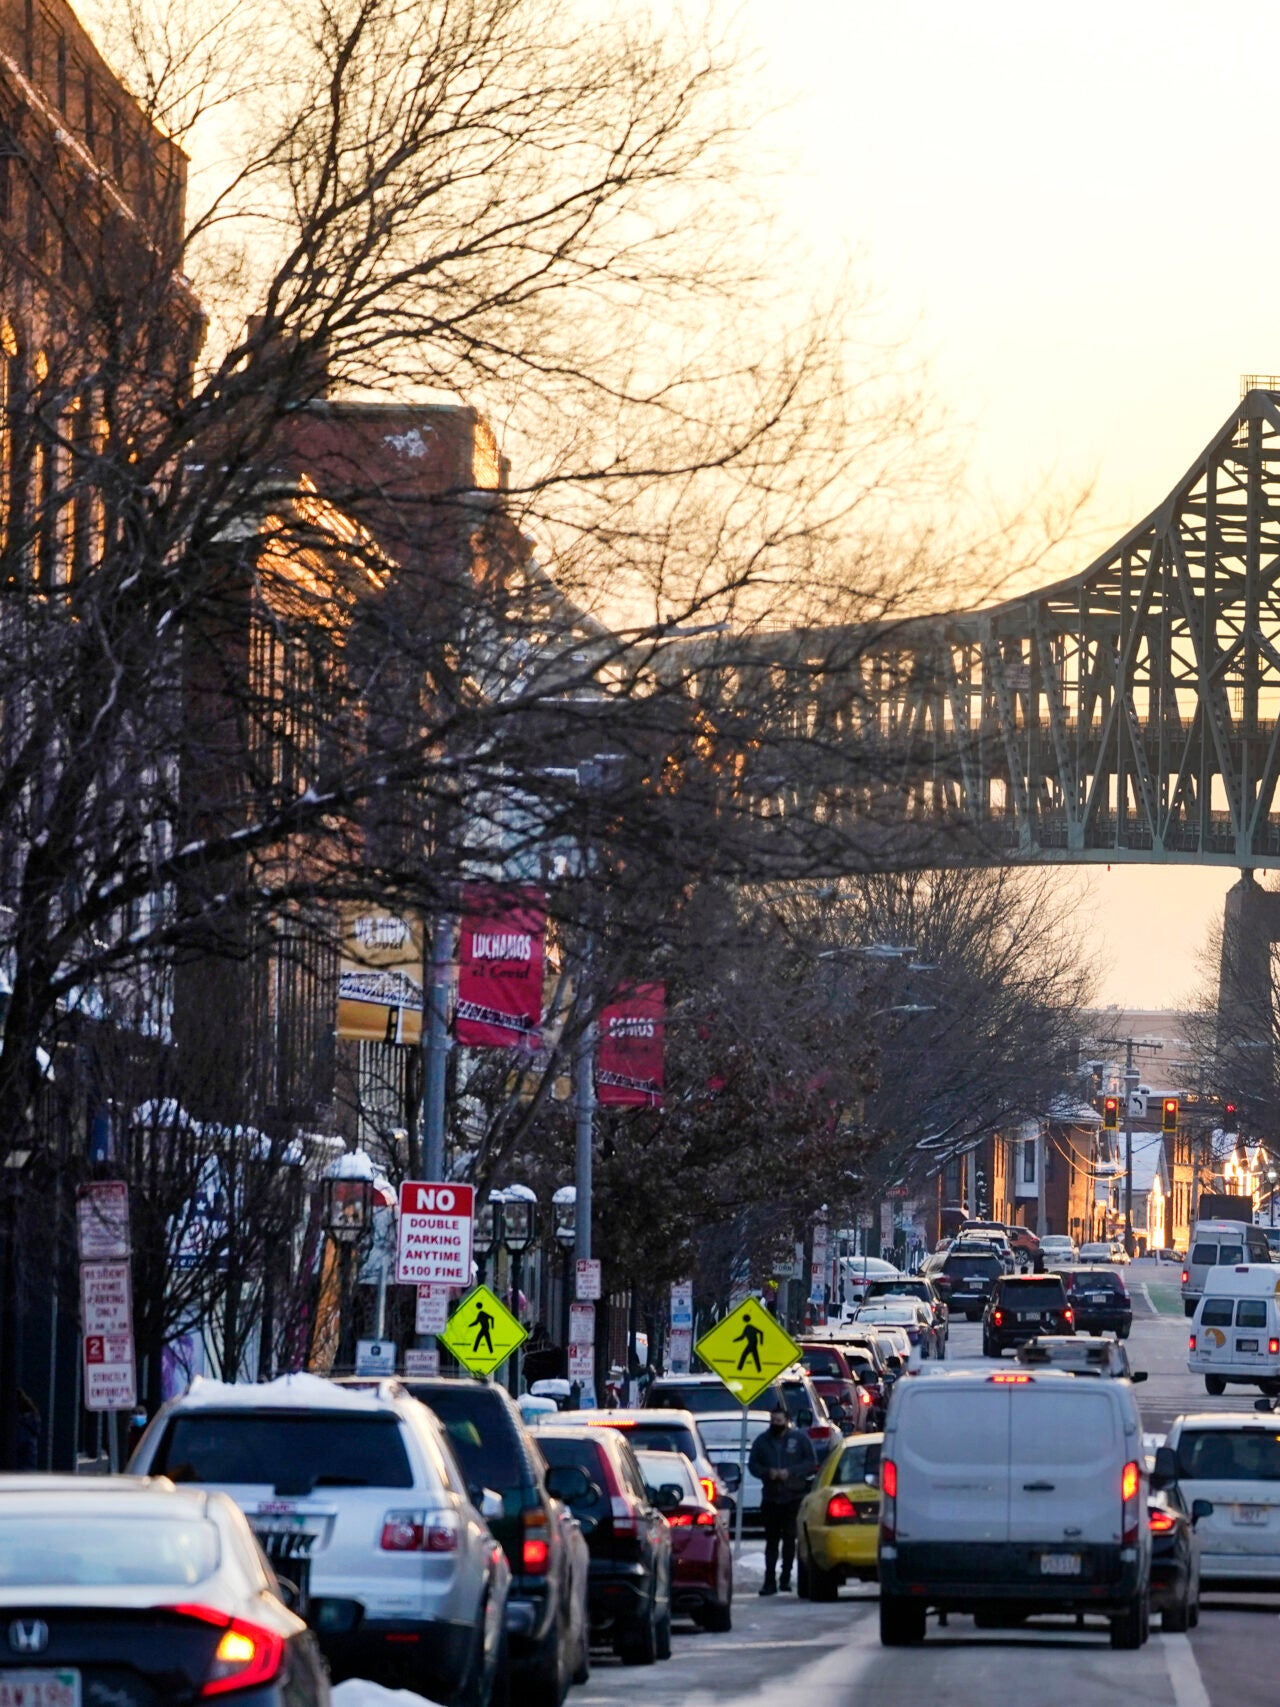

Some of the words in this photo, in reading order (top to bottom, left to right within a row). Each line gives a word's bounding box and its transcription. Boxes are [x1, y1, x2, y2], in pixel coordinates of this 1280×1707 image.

[472, 933, 532, 960] LUCHAMOS
[416, 1188, 456, 1212] NO
[410, 1218, 460, 1230] DOUBLE
[406, 1234, 462, 1247] PARKING
[405, 1250, 461, 1262] ANYTIME
[402, 1265, 431, 1277] $100
[435, 1267, 463, 1278] FINE
[89, 1338, 101, 1355] 2
